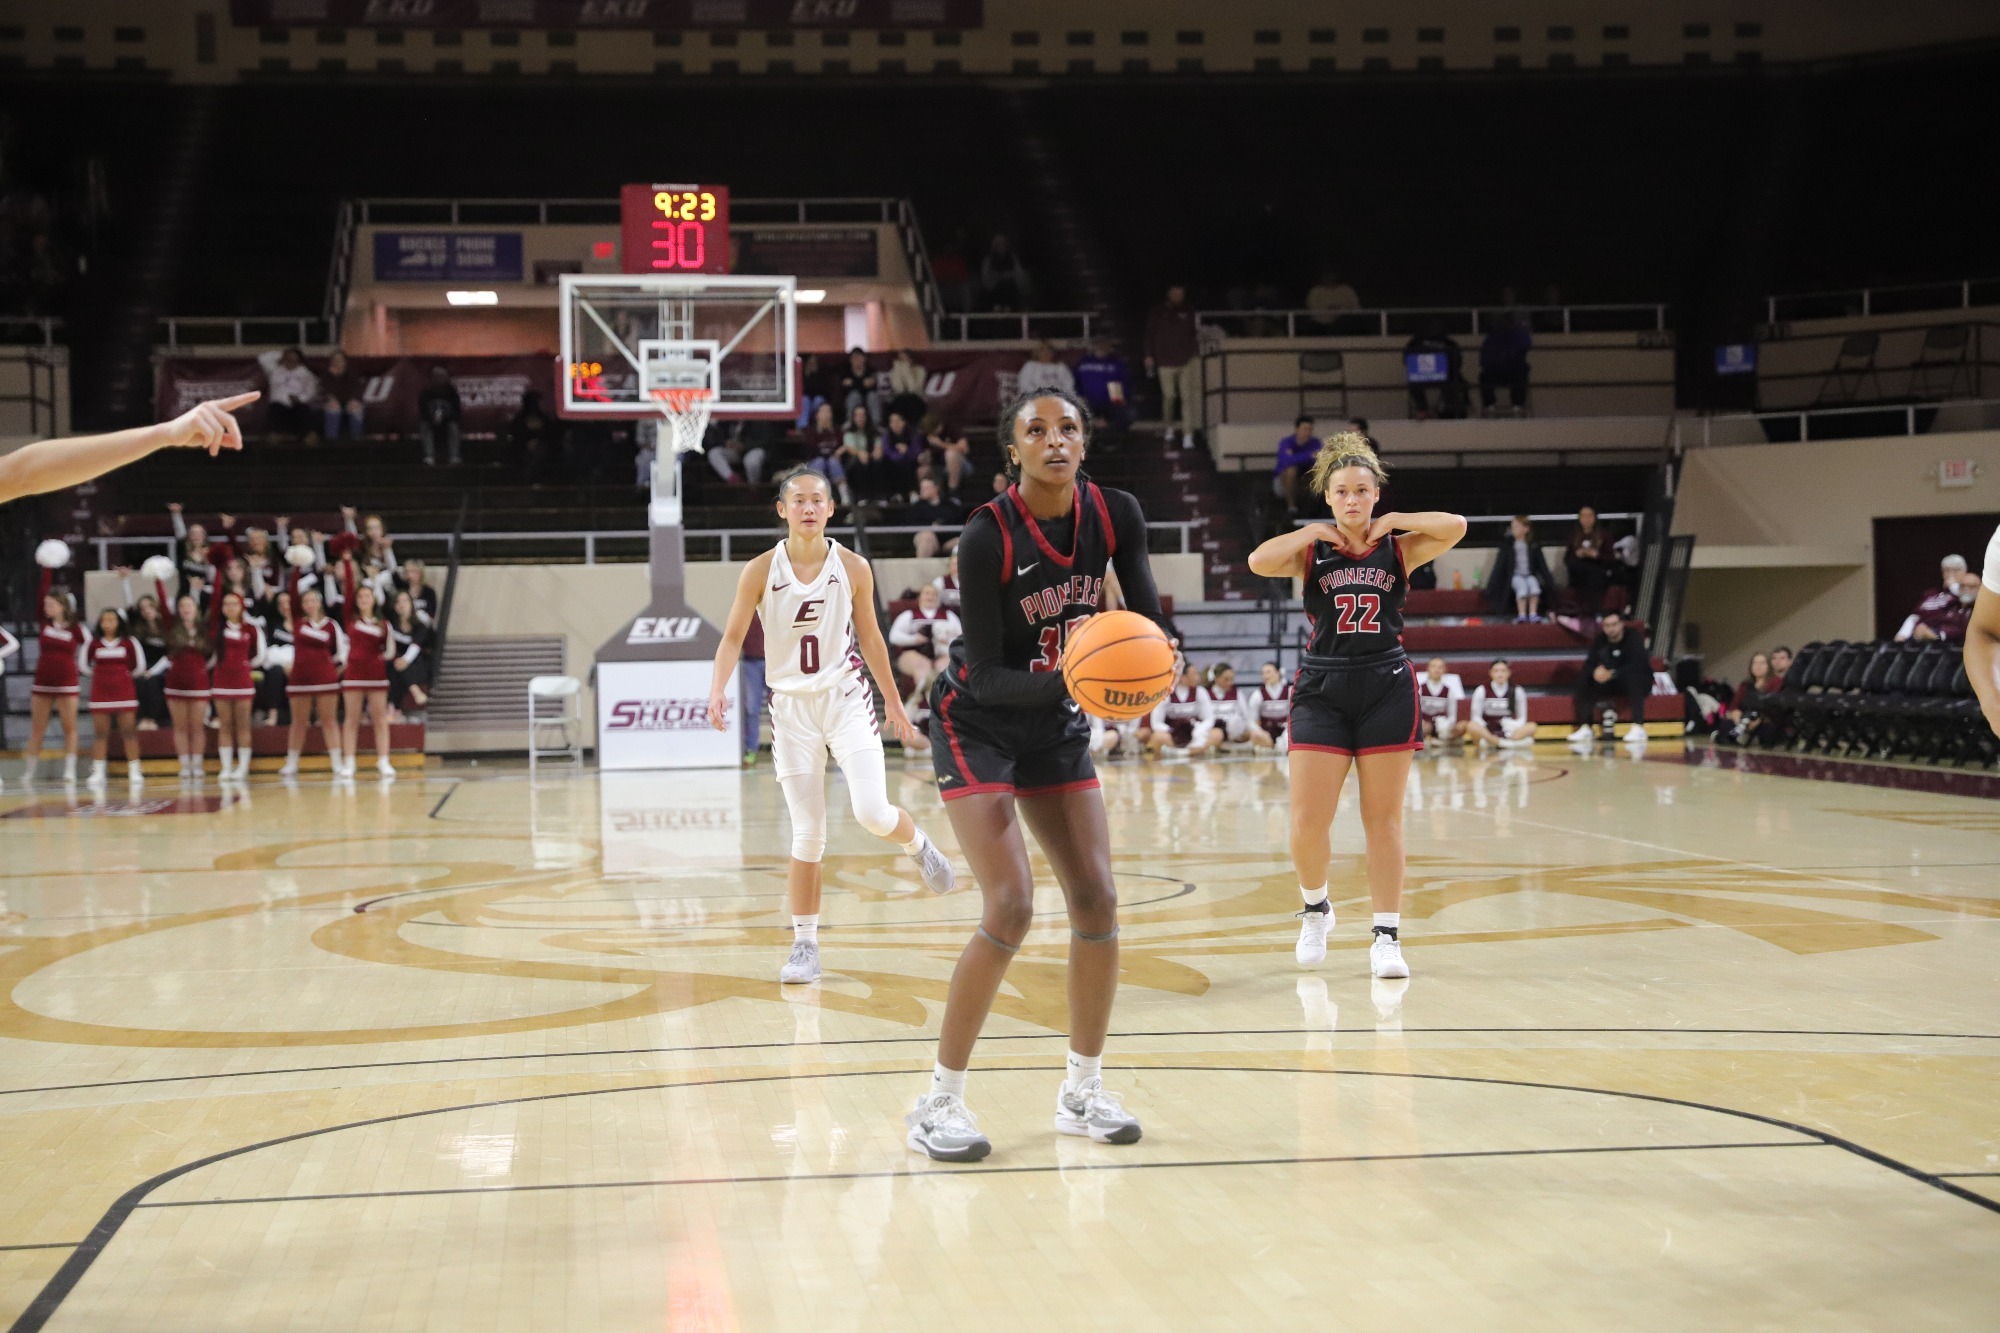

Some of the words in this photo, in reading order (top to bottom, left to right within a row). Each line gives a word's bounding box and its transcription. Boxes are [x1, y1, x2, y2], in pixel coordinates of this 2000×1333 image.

[654, 192, 716, 221] 9:23
[651, 221, 705, 269] 30
[1319, 567, 1396, 594] PIONEERS
[794, 599, 825, 622] E
[1334, 594, 1380, 634] 22
[627, 617, 702, 638] EKU
[800, 635, 820, 674] 0
[1030, 614, 1090, 673] 3
[1104, 688, 1168, 707] Wilson
[607, 700, 734, 728] SHOR
